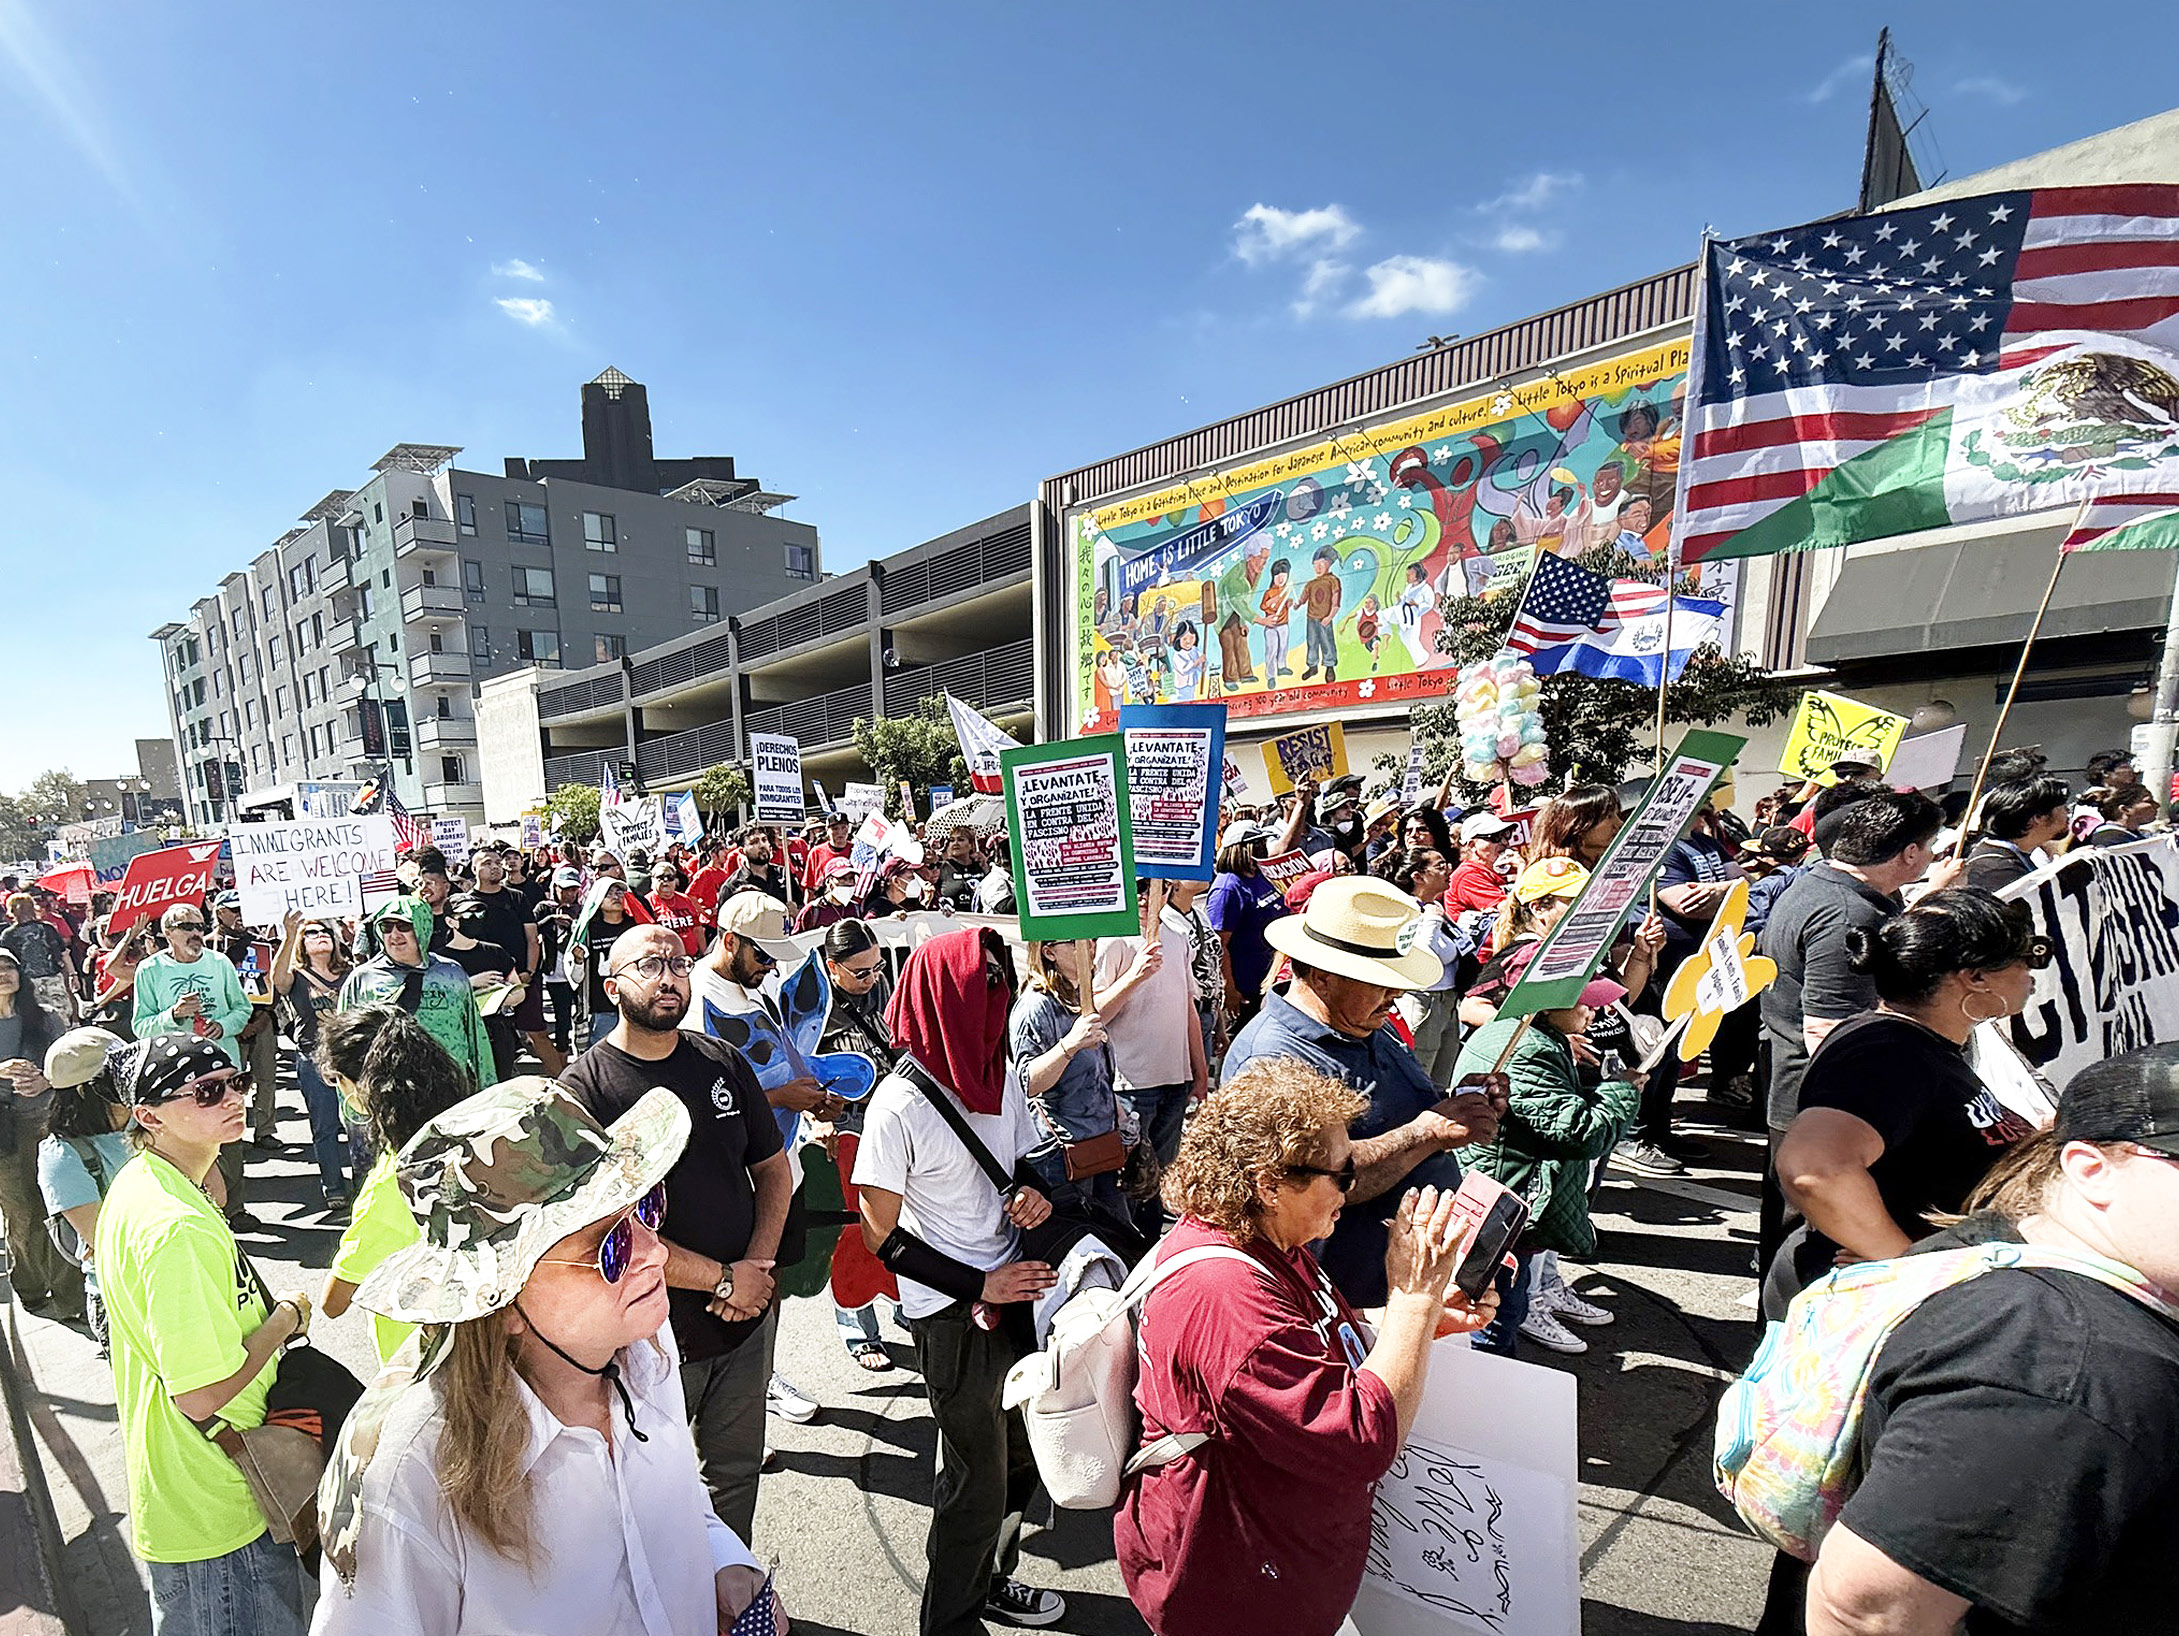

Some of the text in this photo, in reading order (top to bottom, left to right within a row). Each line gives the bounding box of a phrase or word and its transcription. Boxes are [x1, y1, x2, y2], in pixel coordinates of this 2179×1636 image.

[1518, 350, 1689, 405] Little Tokyo is a Spiritual Pla
[1119, 506, 1138, 521] Tokyo
[1153, 491, 1187, 511] Gathering
[1210, 482, 1221, 494] and
[1225, 467, 1269, 488] Destination
[1273, 462, 1285, 476] for
[1288, 450, 1325, 471] Japanese
[1330, 437, 1370, 460] American
[1373, 425, 1424, 448] community
[1428, 418, 1444, 433] and
[1125, 502, 1261, 588] HOME IS LITTLE TOKYO
[1387, 675, 1443, 691] Little Tokyo
[1270, 693, 1286, 707] year
[1289, 690, 1300, 701] old
[1303, 687, 1349, 699] community
[756, 741, 797, 756] ¡DERECHOS
[1276, 725, 1332, 762] RESIST
[757, 756, 799, 774] PLENOS
[1140, 768, 1168, 777] FRENTE
[1172, 769, 1196, 777] UNIDA
[1140, 777, 1167, 785] CONTRA
[1171, 777, 1186, 785] DEL
[1020, 797, 1027, 806] Y
[1026, 802, 1104, 819] LA FRENTE UNIDA
[621, 820, 648, 835] PROTECT
[1027, 814, 1094, 828] EN CONTRA DEL
[231, 824, 363, 855] IMMIGRANTS
[622, 829, 653, 846] FAMILIES
[1028, 827, 1069, 838] FASCISMO
[250, 861, 291, 885] ARE
[301, 849, 391, 878] WELCOME
[114, 870, 208, 912] HUELGA
[285, 881, 352, 912] HERE!
[661, 916, 694, 929] HERE
